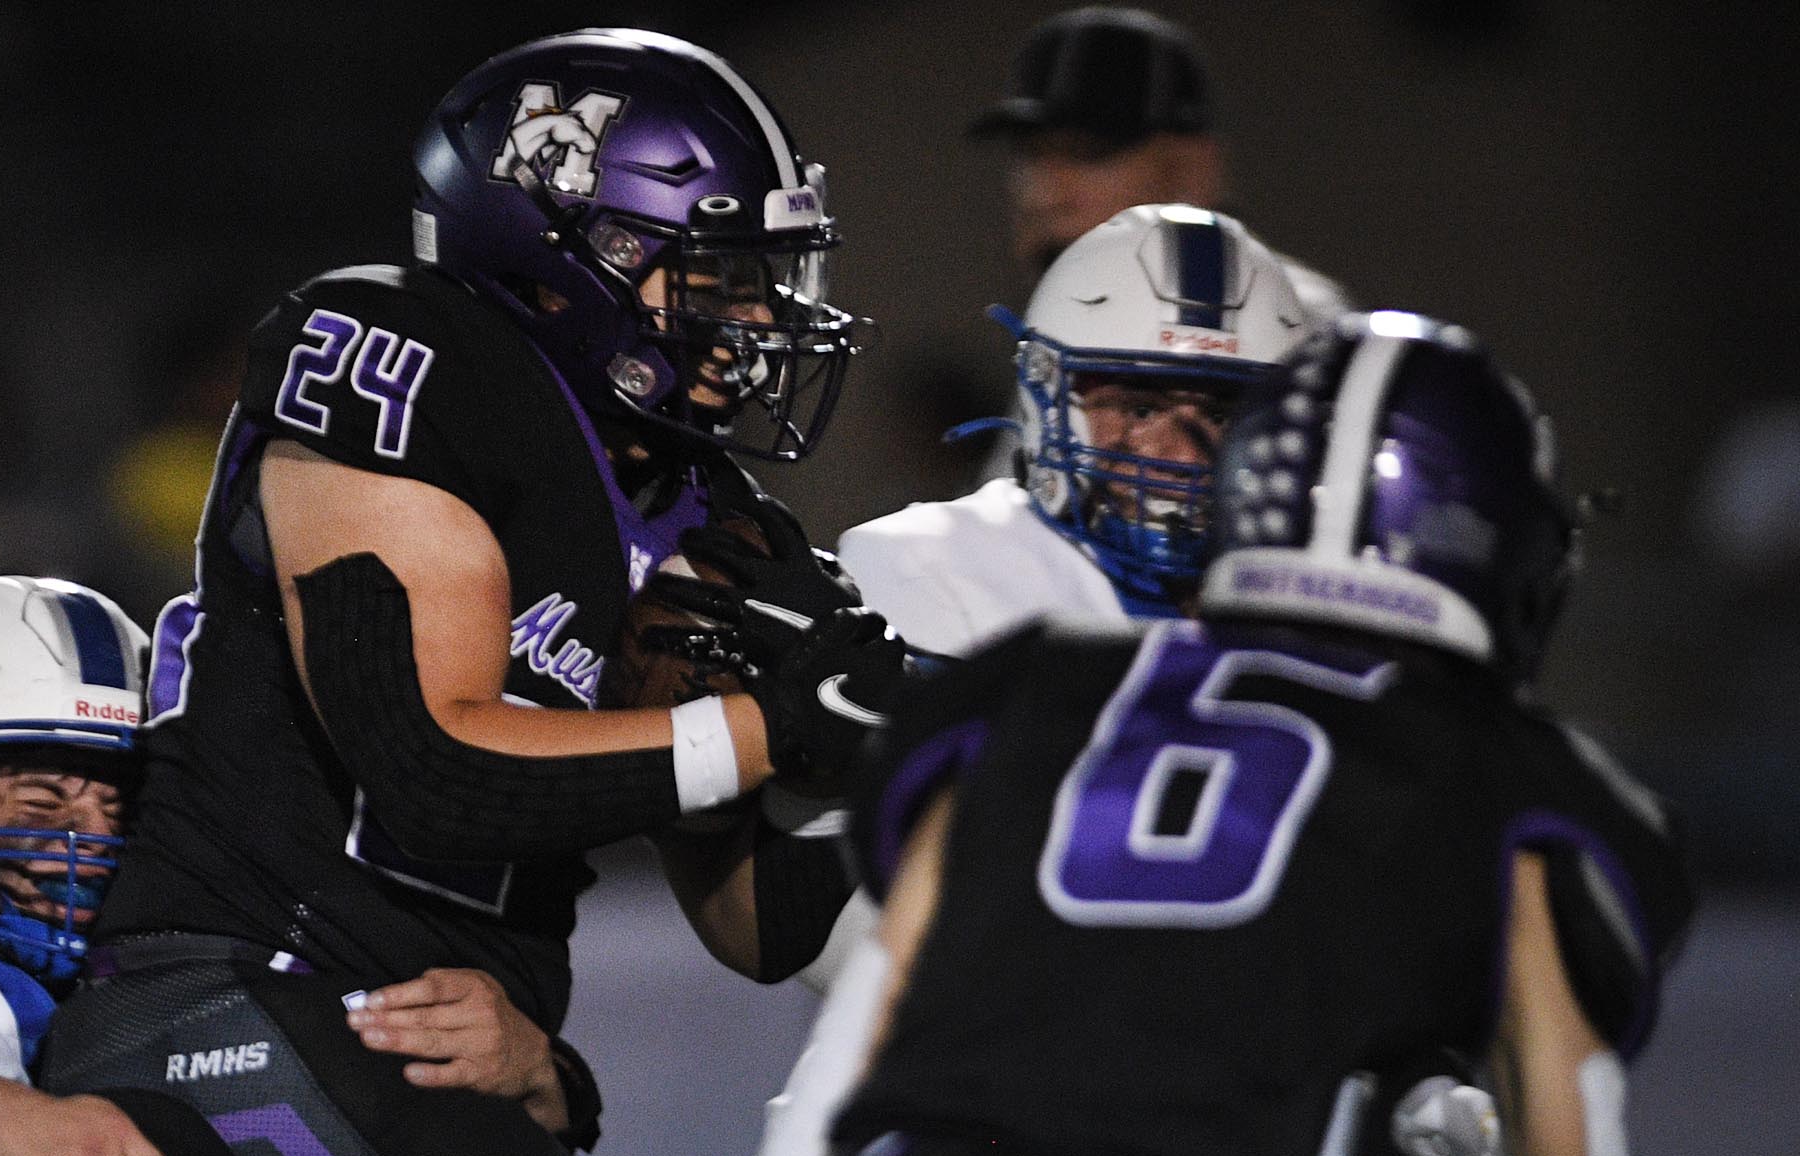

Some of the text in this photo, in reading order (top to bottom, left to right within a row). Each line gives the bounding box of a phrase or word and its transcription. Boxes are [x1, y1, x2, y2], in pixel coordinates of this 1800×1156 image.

[274, 308, 435, 460] 24
[1035, 618, 1400, 930] 6
[165, 1041, 270, 1081] RMHS
